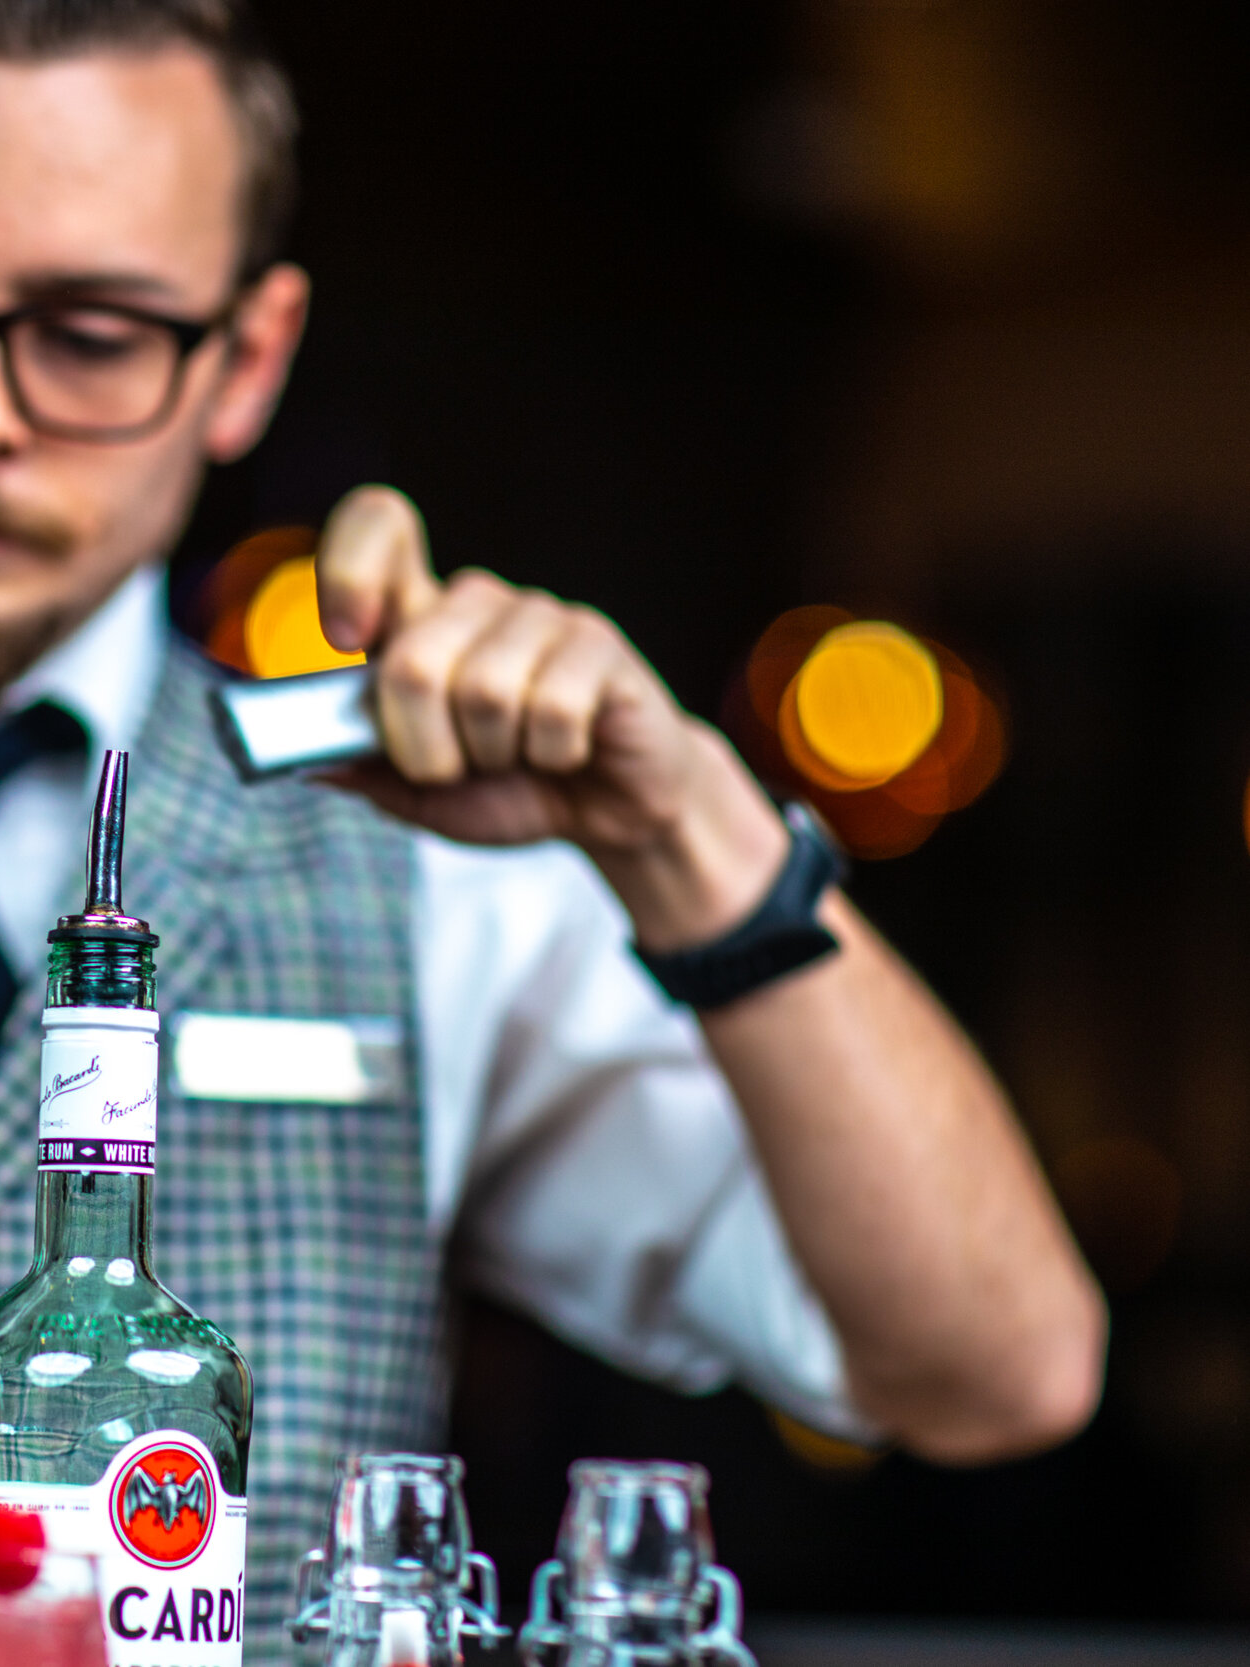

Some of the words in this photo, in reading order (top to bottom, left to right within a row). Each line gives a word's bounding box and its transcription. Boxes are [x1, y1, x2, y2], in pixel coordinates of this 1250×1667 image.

[48, 1142, 74, 1161] RUM
[103, 1142, 146, 1164] WHITE
[109, 1571, 243, 1643] CARDÍ
